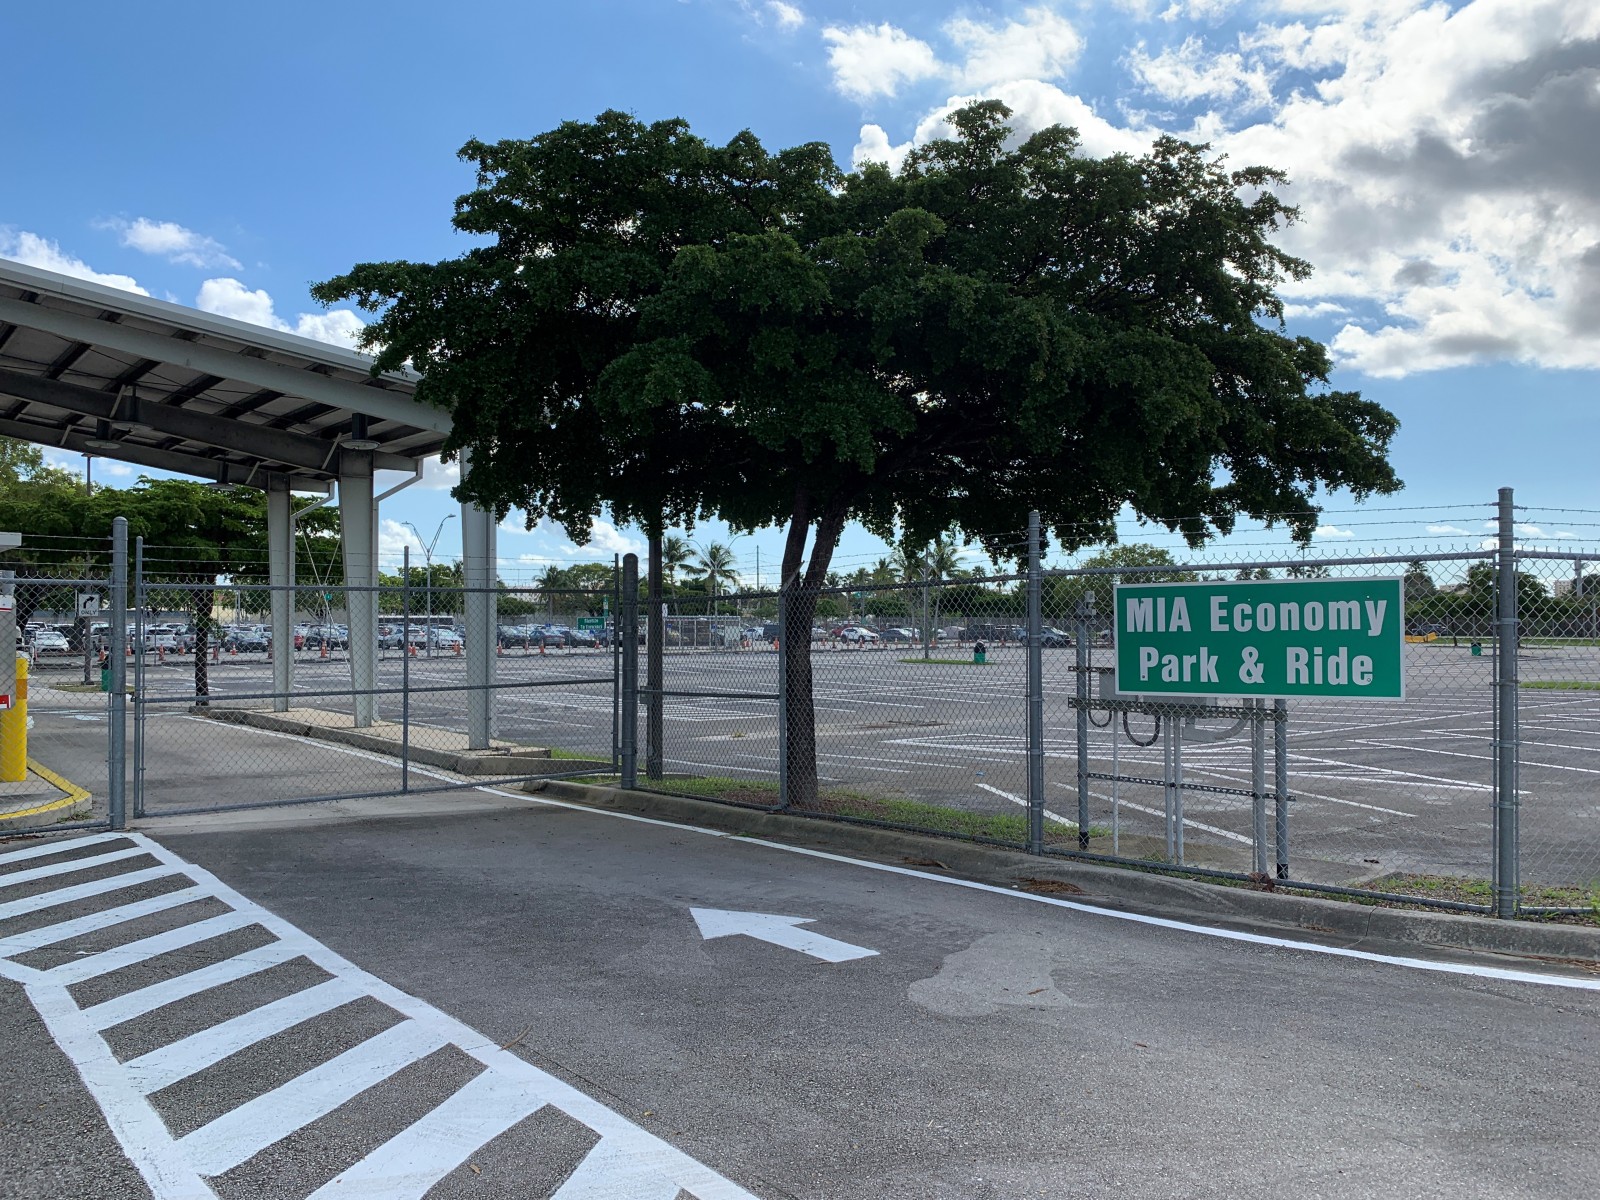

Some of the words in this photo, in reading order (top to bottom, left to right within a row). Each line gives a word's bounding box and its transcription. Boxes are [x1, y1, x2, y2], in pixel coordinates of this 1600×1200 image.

[1126, 597, 1192, 632] MIA
[1210, 595, 1387, 637] Economy
[1139, 647, 1219, 683] Park
[1239, 647, 1265, 684] &
[1286, 647, 1373, 686] Ride
